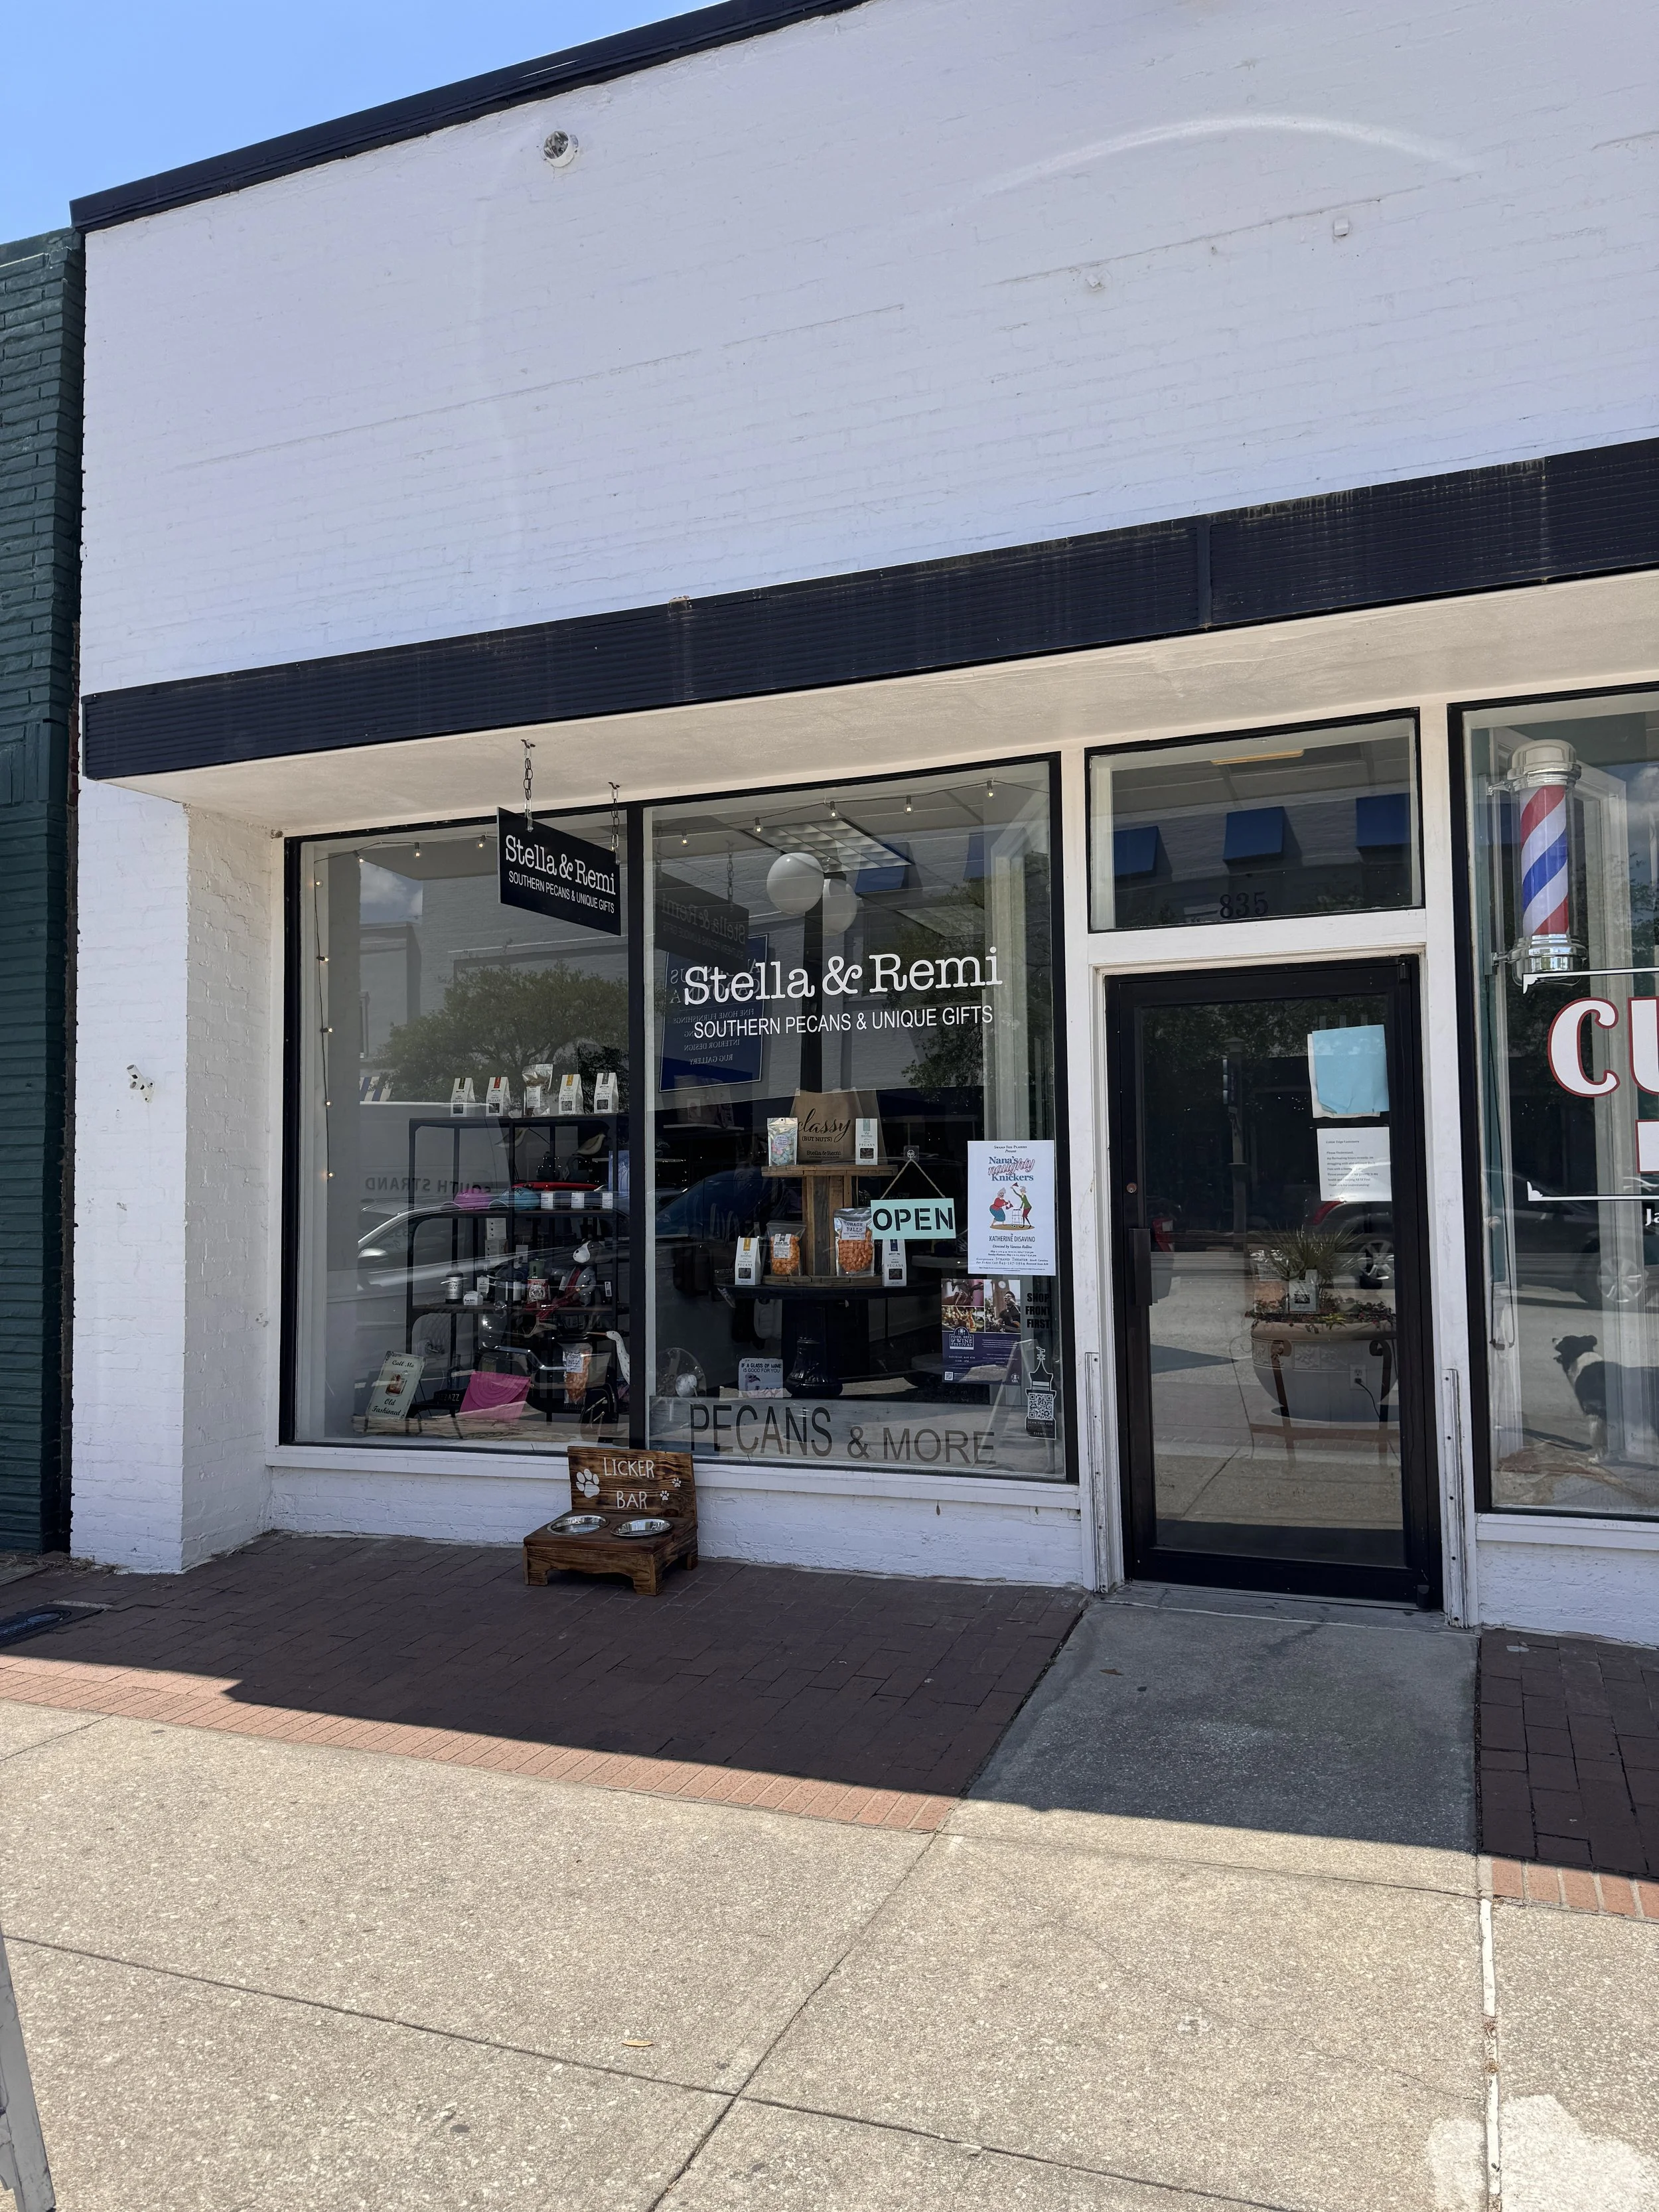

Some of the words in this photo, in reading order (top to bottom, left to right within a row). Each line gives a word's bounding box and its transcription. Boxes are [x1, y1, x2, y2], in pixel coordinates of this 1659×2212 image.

[506, 835, 557, 876] Stella
[559, 853, 573, 881] &
[575, 859, 616, 895] Remi
[508, 870, 545, 893] SOUTHERN
[545, 882, 570, 900] PECANS
[571, 890, 575, 901] &
[576, 891, 598, 909] UNIQUE
[599, 899, 614, 914] GIFTS
[1220, 891, 1269, 919] 835
[684, 961, 815, 1006] Stella
[822, 956, 863, 995] &
[869, 946, 1003, 994] Remi
[694, 1017, 780, 1039] SOUTHERN
[786, 1011, 852, 1034] PECANS
[856, 1012, 867, 1030] &
[872, 1008, 938, 1029] UNIQUE
[942, 1005, 993, 1025] GIFTS
[987, 1157, 1035, 1176] naughty
[873, 1207, 954, 1231] OPEN
[1027, 1292, 1050, 1302] SHOP
[1025, 1305, 1050, 1315] FRONT
[1027, 1318, 1050, 1329] FIRST
[372, 1405, 401, 1416] Fashioned
[690, 1404, 832, 1456] PECANS
[847, 1426, 871, 1459] &
[883, 1428, 995, 1465] MORE
[603, 1457, 655, 1479] LICKER
[616, 1491, 648, 1510] BAR
